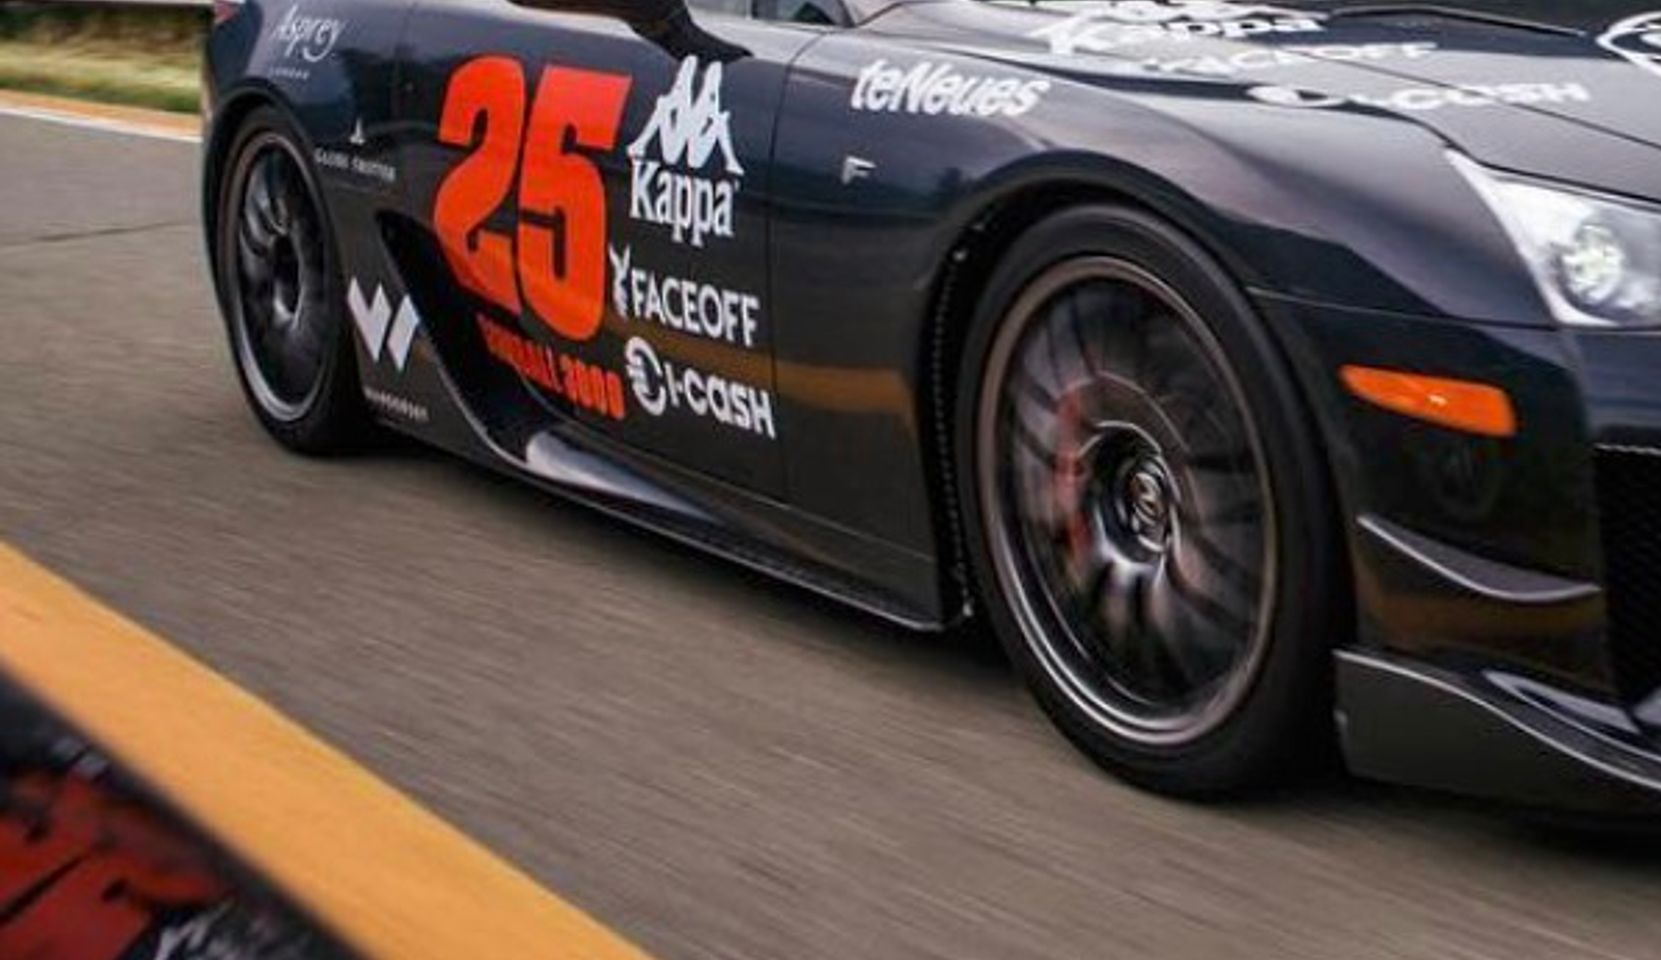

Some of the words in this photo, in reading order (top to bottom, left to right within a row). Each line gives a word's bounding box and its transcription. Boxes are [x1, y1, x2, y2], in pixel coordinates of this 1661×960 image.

[851, 58, 1051, 116] teNeues
[433, 53, 632, 341] 25
[628, 157, 735, 247] Kappa
[630, 266, 760, 348] FACEOFF
